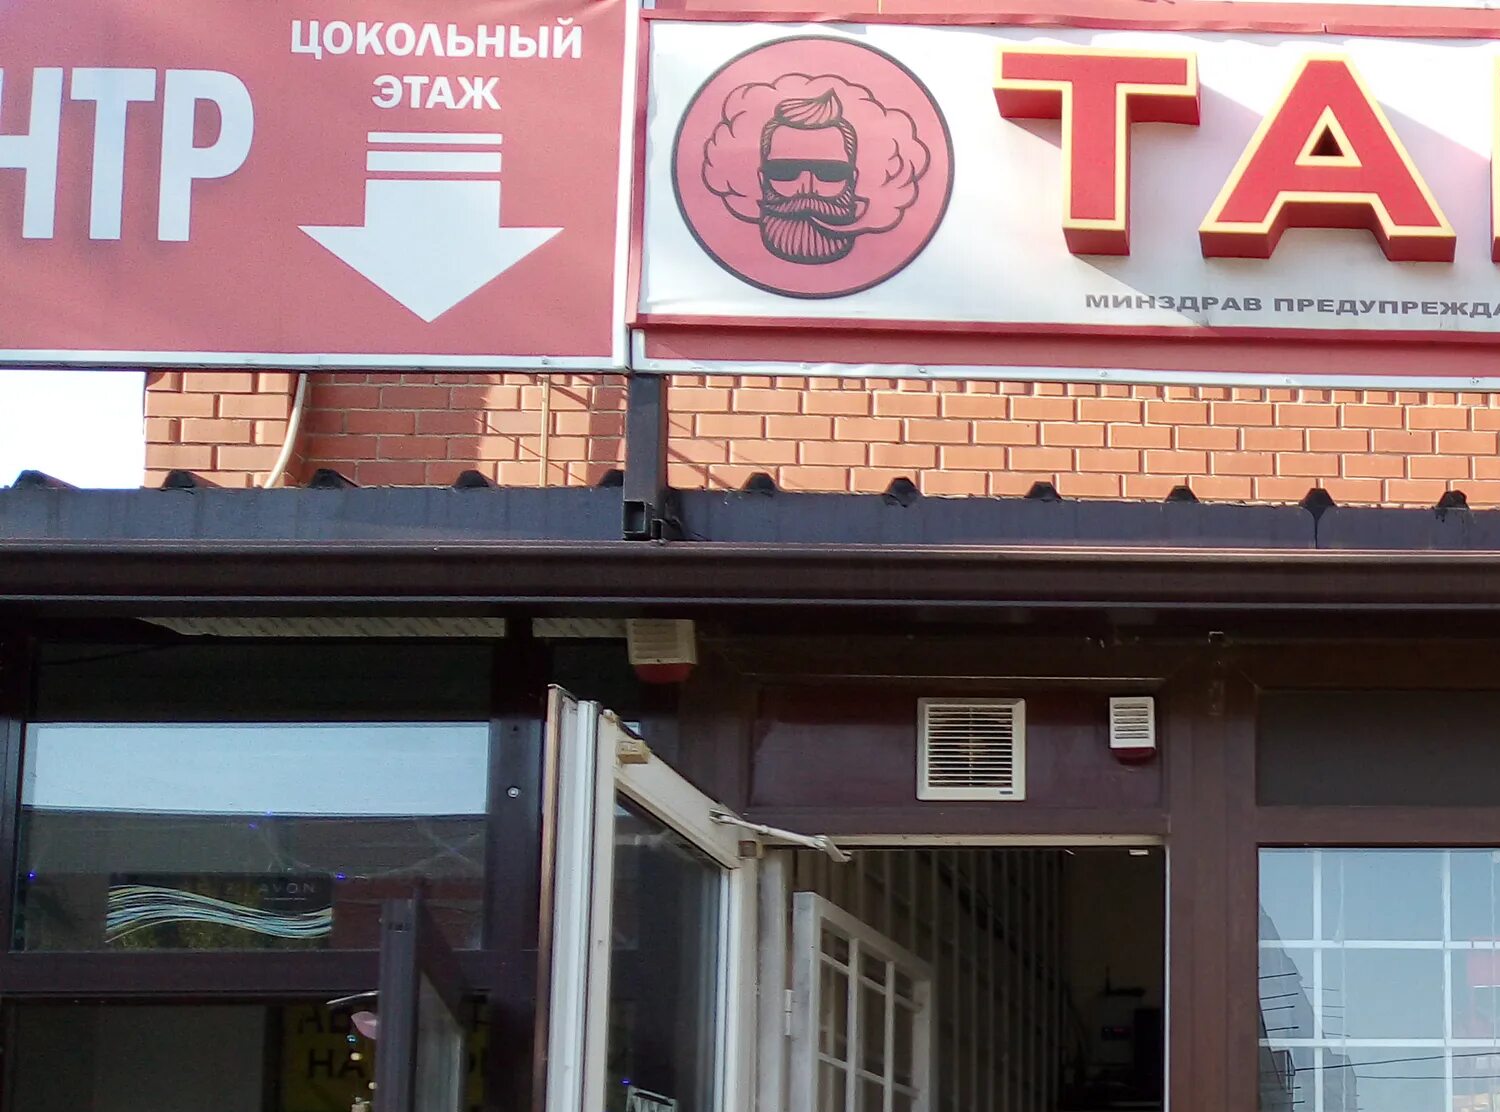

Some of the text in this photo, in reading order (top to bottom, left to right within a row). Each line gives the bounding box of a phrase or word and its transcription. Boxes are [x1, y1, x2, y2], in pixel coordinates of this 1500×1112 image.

[290, 17, 584, 61] ЦОКОЛЬНЫЙ
[371, 74, 502, 111] ЭТАЖ
[0, 67, 256, 242] НТР
[1085, 292, 1263, 313] МИНЗДРАВ
